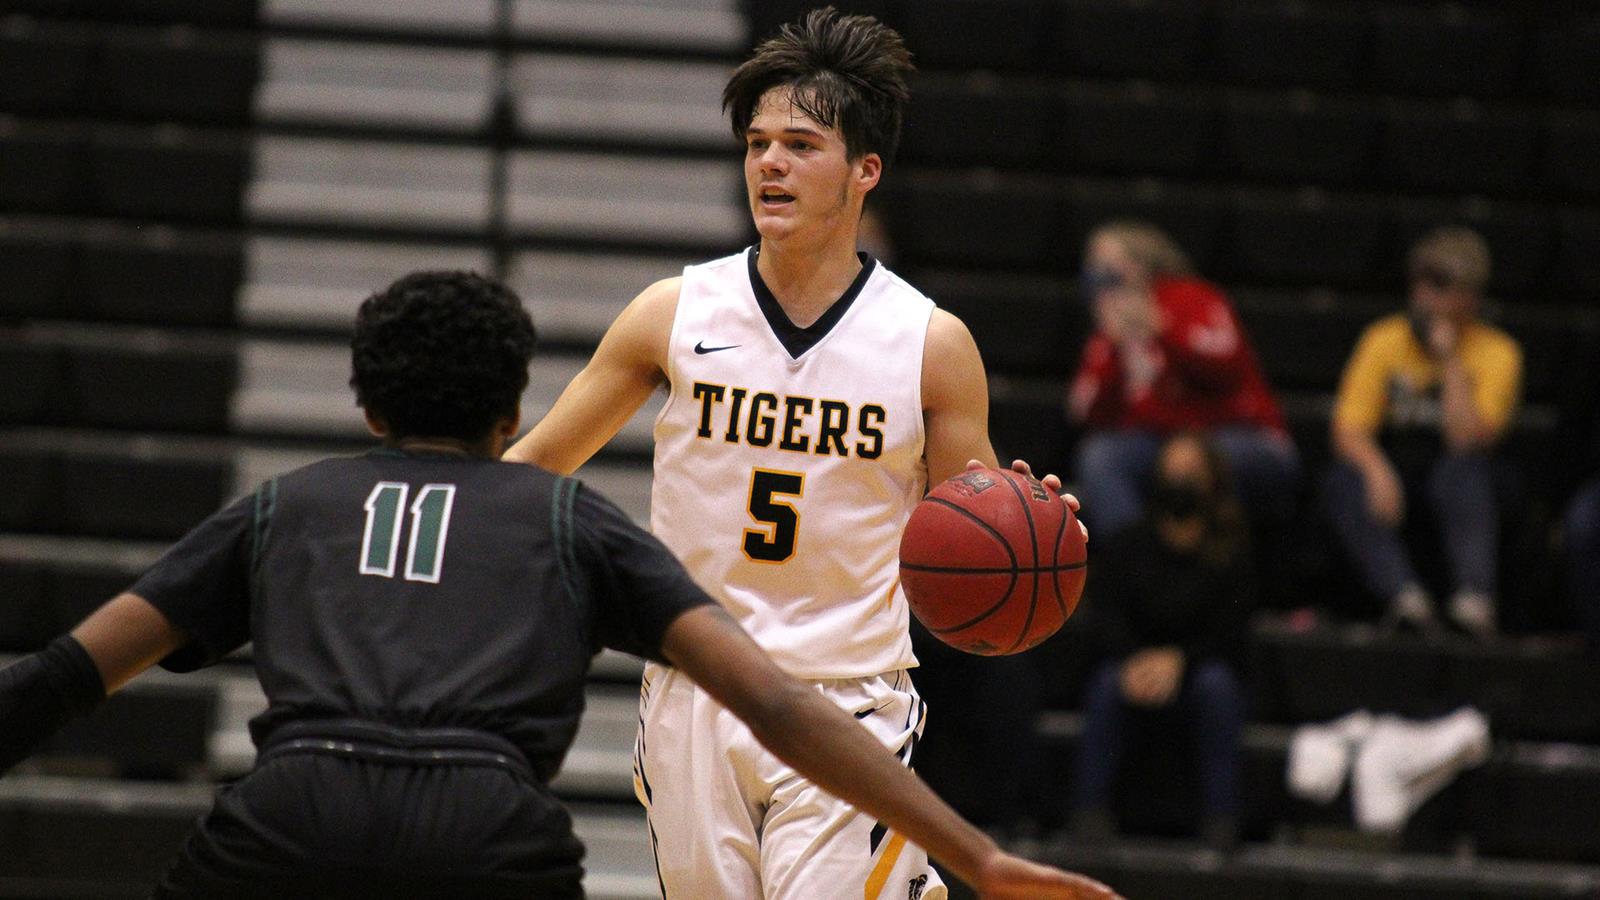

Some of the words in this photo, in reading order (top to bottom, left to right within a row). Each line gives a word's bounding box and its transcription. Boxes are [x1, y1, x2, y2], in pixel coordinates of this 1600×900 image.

[692, 380, 888, 462] TIGERS
[359, 481, 456, 584] 11
[740, 466, 806, 565] 5
